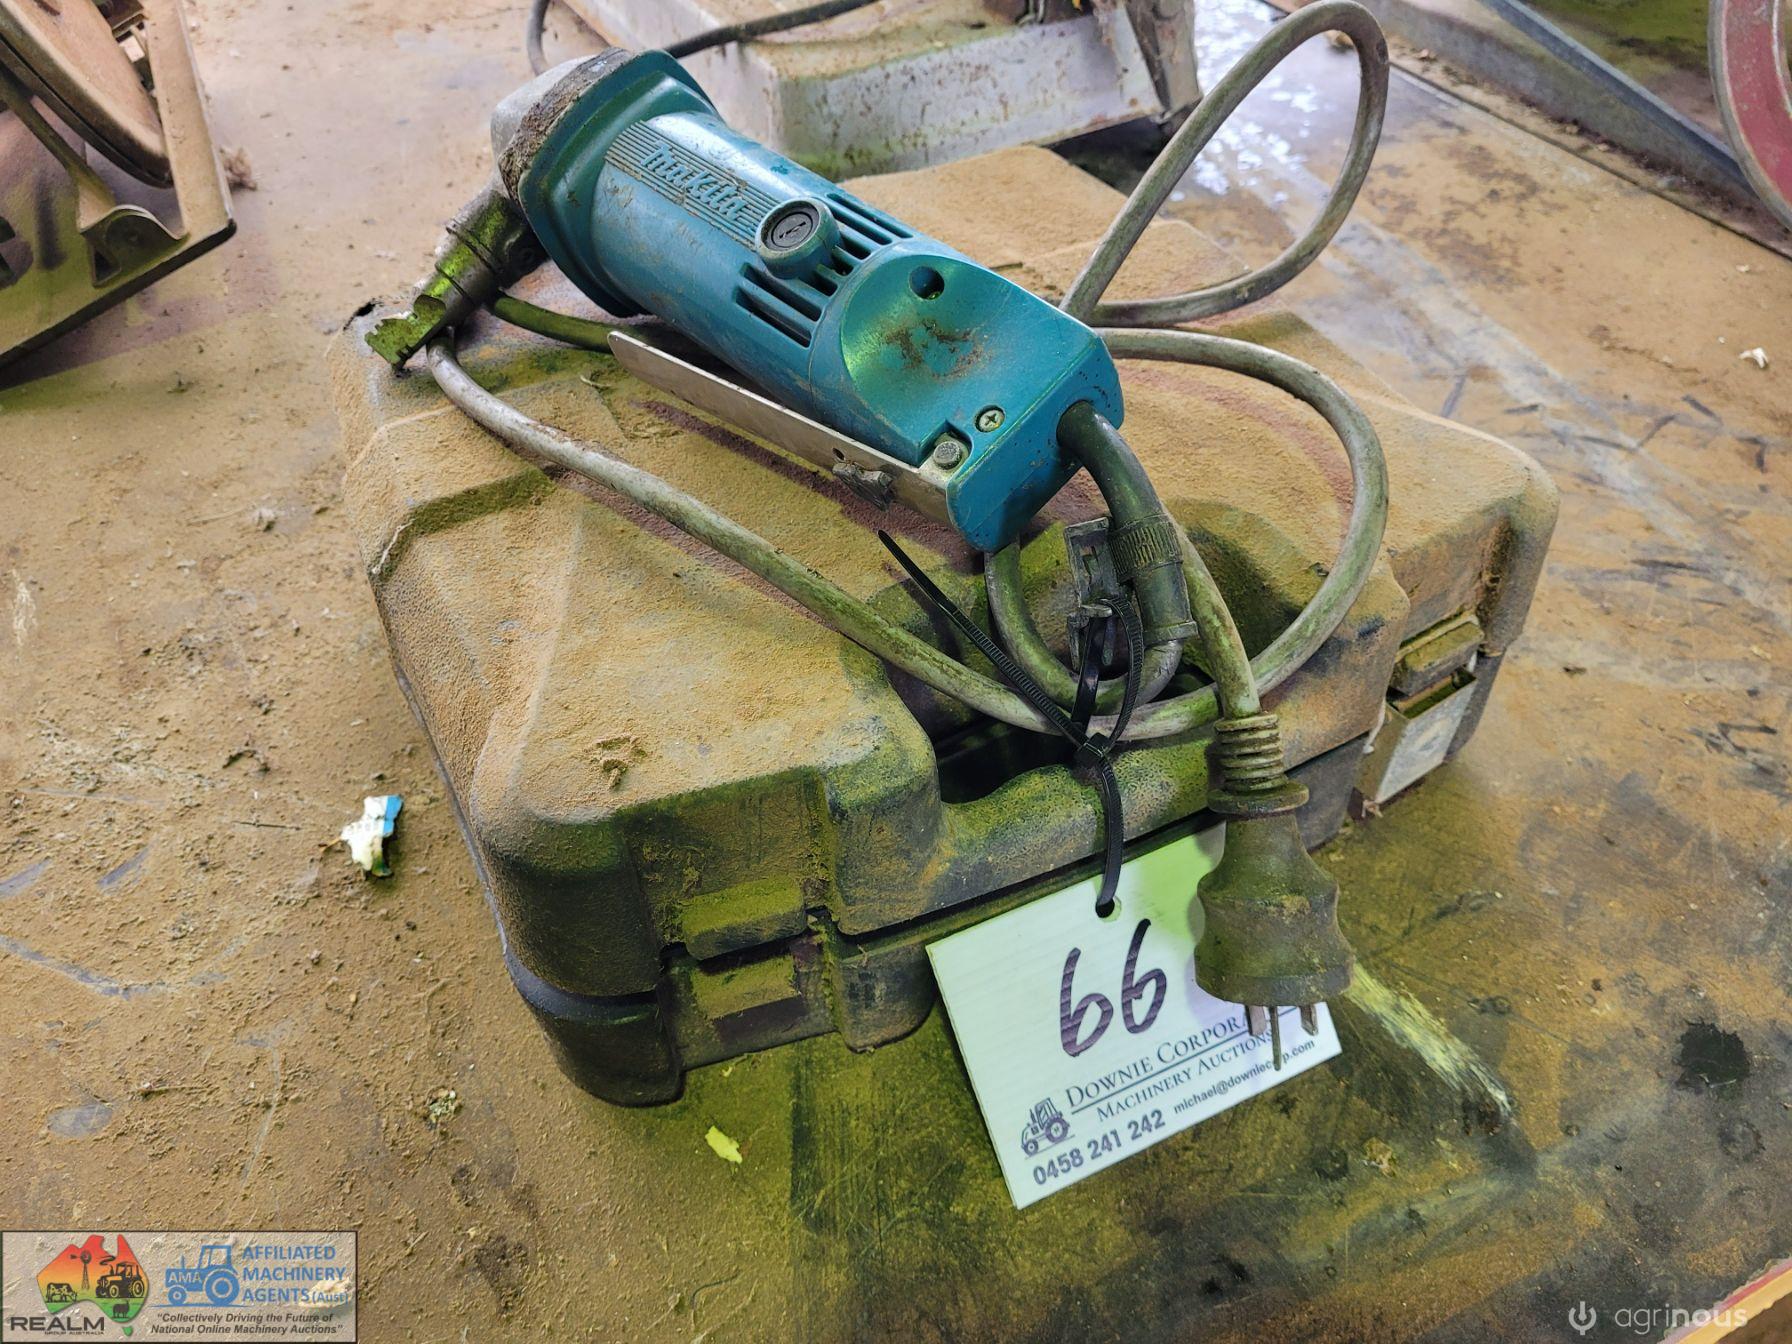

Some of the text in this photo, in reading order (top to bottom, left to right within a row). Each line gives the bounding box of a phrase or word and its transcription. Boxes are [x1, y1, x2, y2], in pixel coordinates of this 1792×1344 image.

[1060, 918, 1167, 1057] 66
[1065, 1055, 1153, 1108] DOWNIE
[1096, 1067, 1192, 1122] MACHINERY
[1173, 1039, 1315, 1114] michael@downiecp.com
[1033, 1109, 1166, 1185] 0458 241 242
